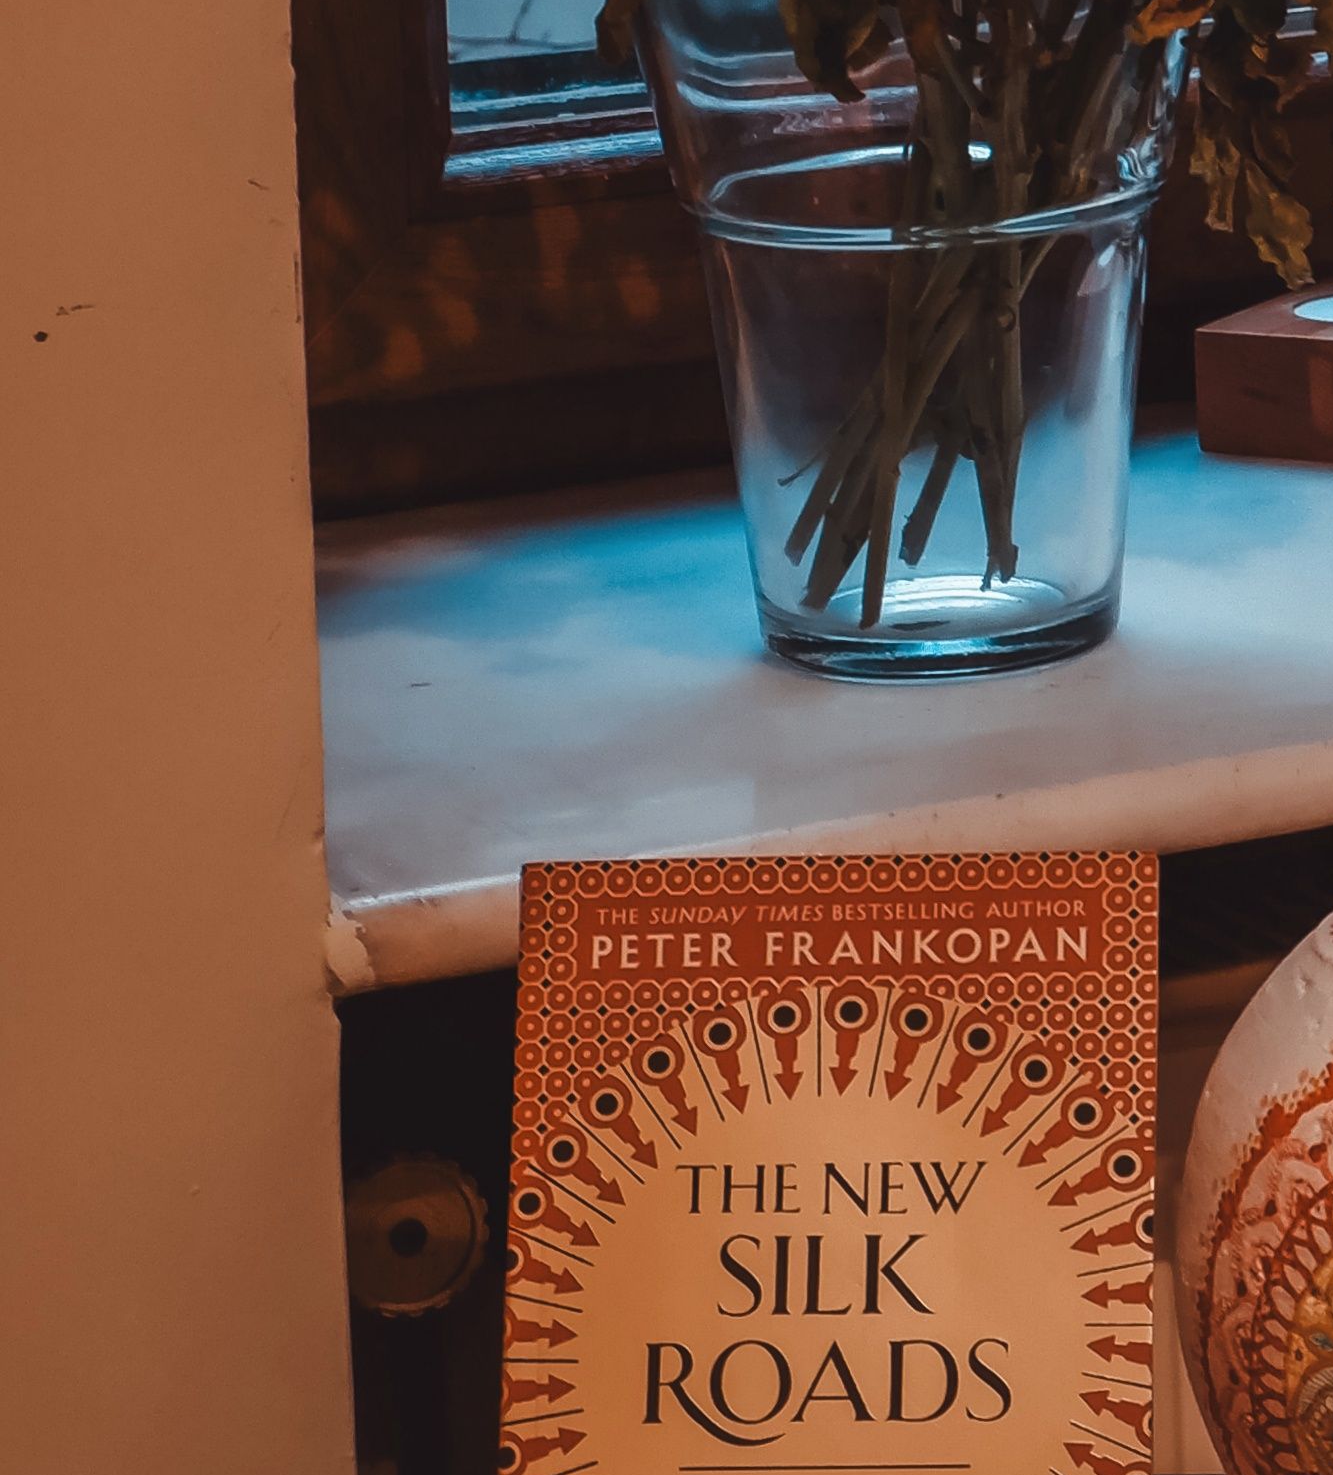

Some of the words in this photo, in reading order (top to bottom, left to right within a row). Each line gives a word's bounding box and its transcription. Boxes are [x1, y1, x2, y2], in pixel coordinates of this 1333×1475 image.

[596, 905, 639, 924] THE
[647, 904, 744, 925] SUNDAY
[752, 903, 824, 923] TIMES
[831, 902, 975, 923] BESTSELLING
[986, 898, 1086, 920] AUTHOR
[590, 930, 737, 969] PETER
[764, 926, 1089, 968] FRANKOPAN
[676, 1164, 800, 1216] THE
[822, 1161, 987, 1216] NEW
[716, 1232, 935, 1318] SILK
[641, 1337, 1012, 1447] ROADS
